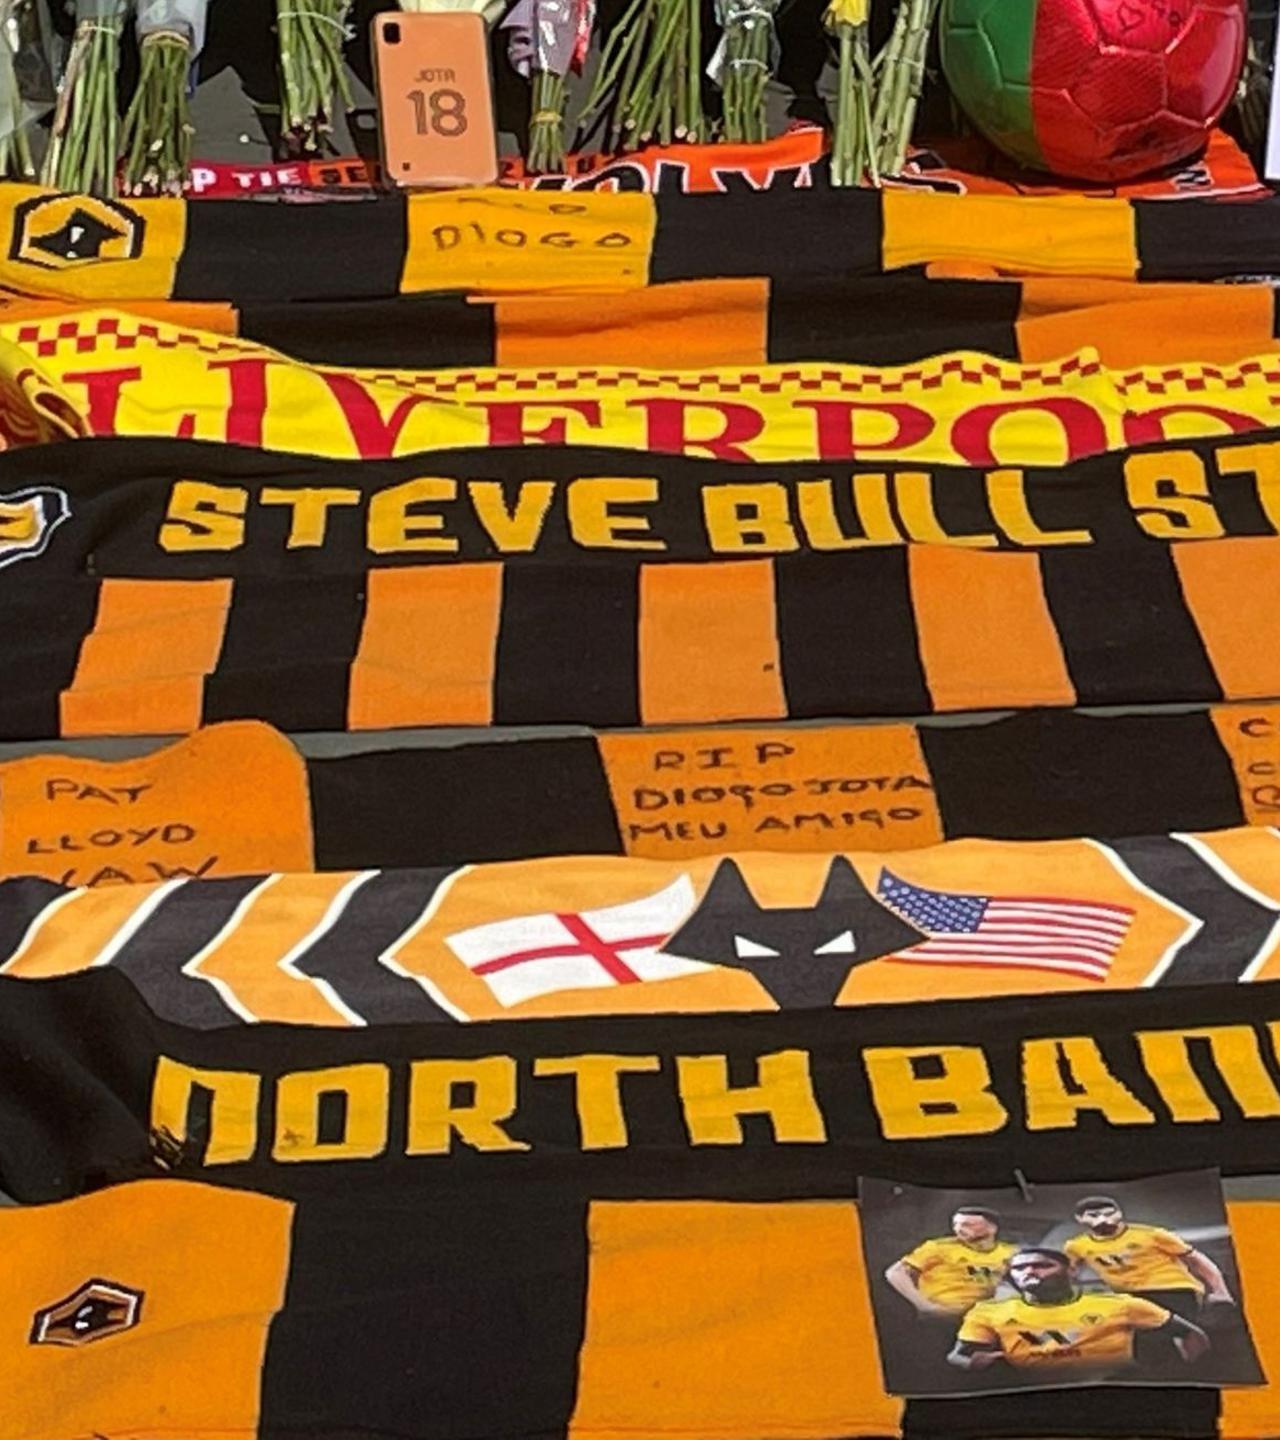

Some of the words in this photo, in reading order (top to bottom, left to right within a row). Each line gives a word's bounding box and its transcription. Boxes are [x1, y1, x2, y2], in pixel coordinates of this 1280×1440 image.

[414, 68, 456, 84] JOTA
[406, 88, 468, 137] 18
[231, 170, 300, 189] TIE
[318, 165, 382, 187] SE
[431, 222, 633, 252] DIOGO
[156, 477, 668, 554] STEVE
[701, 468, 1096, 553] BULL
[653, 741, 796, 772] RIP
[46, 778, 153, 805] PAT
[26, 823, 197, 855] LLOYD
[628, 820, 728, 843] MEU
[148, 1048, 828, 1169] NORTH
